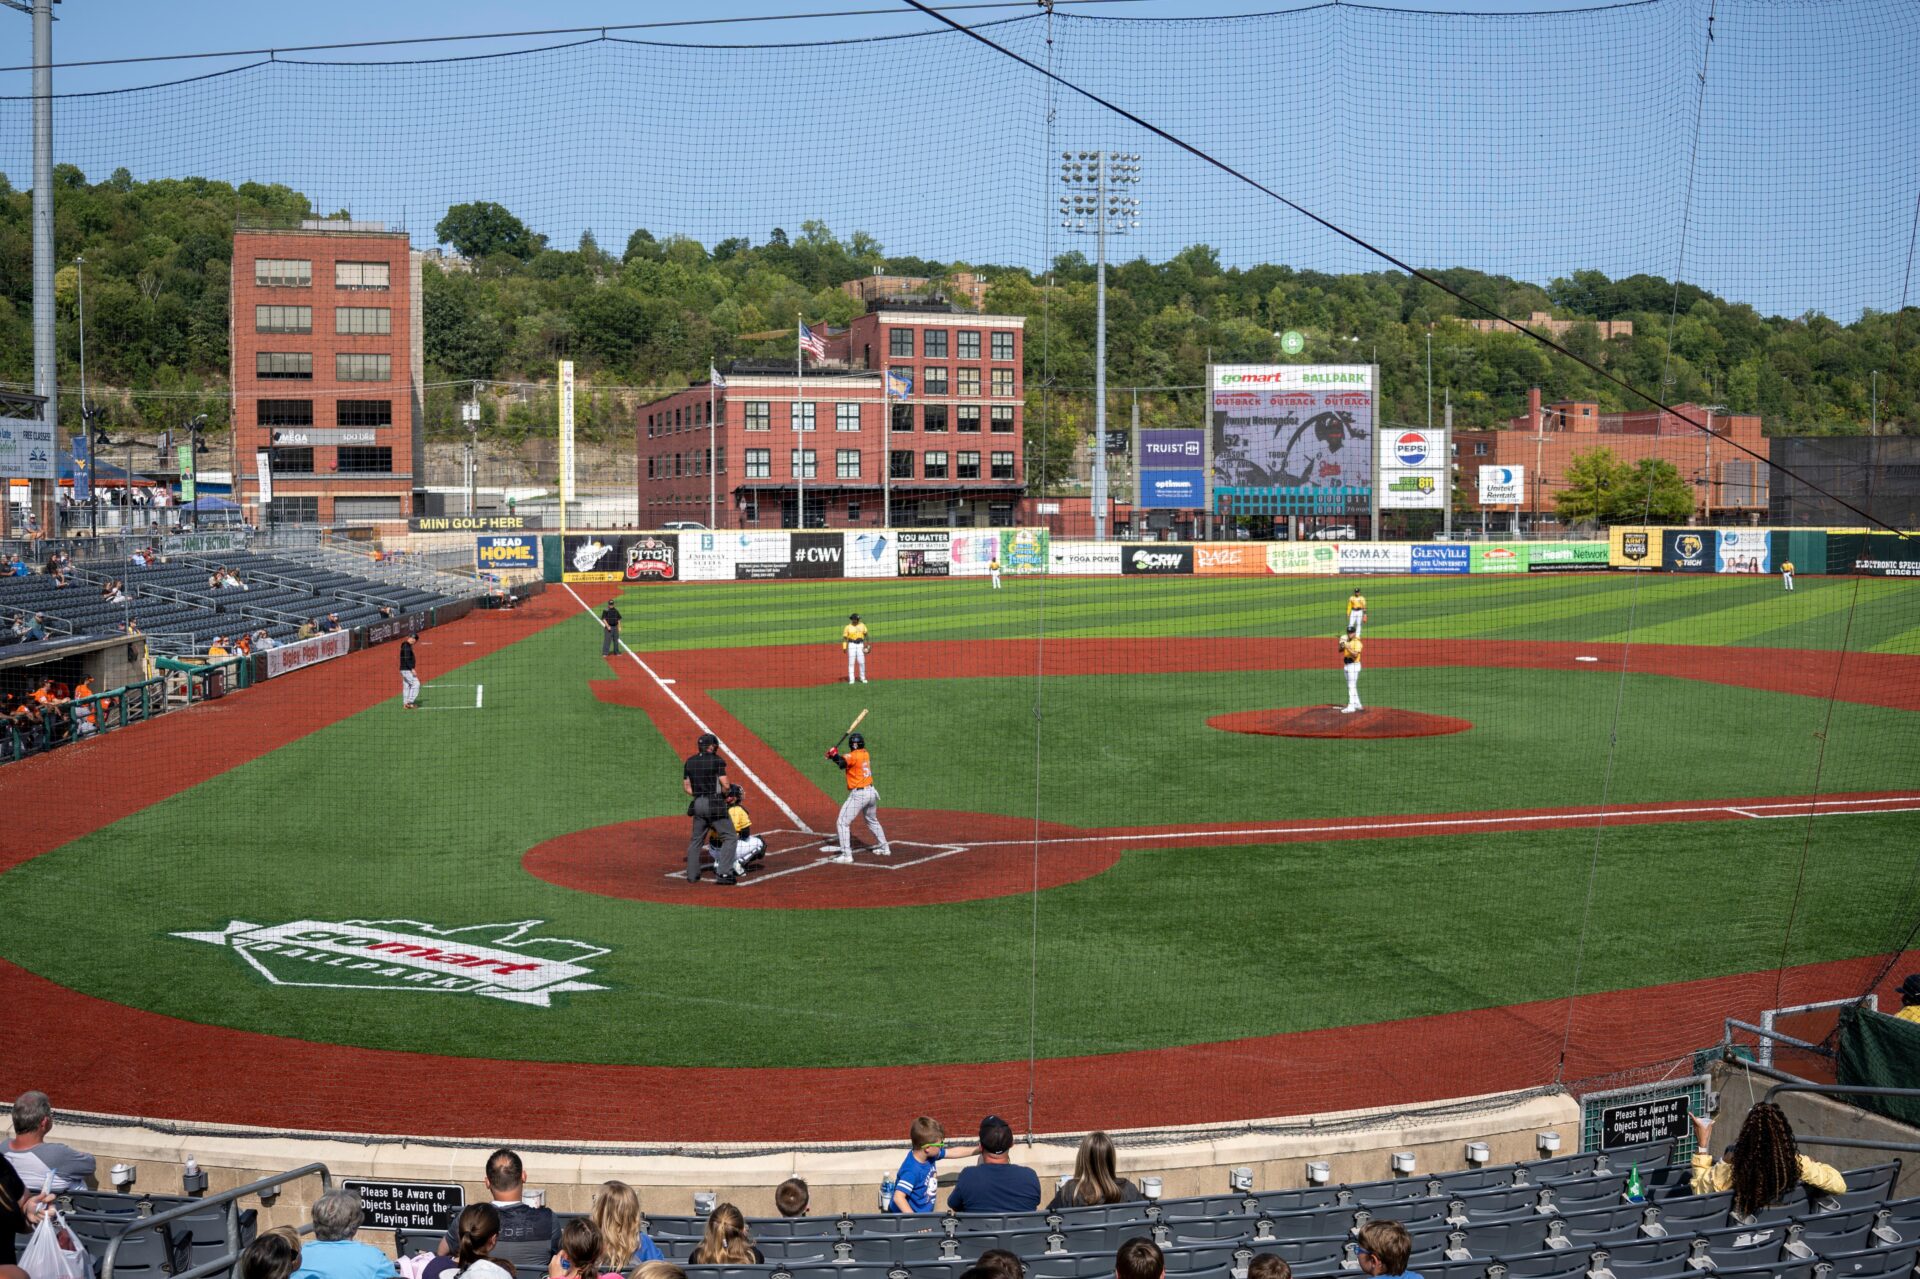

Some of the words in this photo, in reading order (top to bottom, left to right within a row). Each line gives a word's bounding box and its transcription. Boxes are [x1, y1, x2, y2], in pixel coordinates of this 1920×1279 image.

[1221, 373, 1281, 384] gomart
[1302, 373, 1366, 382] BALLPARK
[23, 430, 33, 439] FREE
[1146, 444, 1184, 452] TRUIST
[1418, 477, 1433, 488] 811
[420, 519, 449, 529] MINI
[452, 518, 487, 528] GOLF
[490, 518, 523, 528] HERE
[183, 536, 205, 551] FAMILY
[206, 535, 230, 550] SECTION
[493, 537, 522, 547] HEAD
[918, 533, 948, 541] MATTER
[481, 546, 534, 560] HOME.
[629, 548, 672, 567] PITCH
[795, 548, 842, 562] #CWV
[1341, 549, 1390, 558] KOMAX
[1543, 550, 1573, 560] Health
[1573, 550, 1608, 560] Network
[1149, 554, 1183, 566] CRW
[1855, 560, 1897, 568] ELECTRONIC
[282, 650, 300, 668] Bigley
[303, 645, 318, 662] Piggly
[321, 638, 338, 657] Wiggly
[282, 930, 542, 975] gomart
[250, 943, 471, 988] BALLPARK
[1615, 1109, 1636, 1120] Please
[1638, 1107, 1647, 1116] Be
[1649, 1104, 1669, 1114] Aware
[1671, 1101, 1678, 1110] of
[1614, 1120, 1638, 1134] Objects
[1640, 1117, 1665, 1129] Leaving
[1667, 1114, 1678, 1122] the
[1624, 1131, 1649, 1142] Playing
[360, 1186, 389, 1197] Please
[392, 1188, 403, 1198] Be
[407, 1189, 434, 1200] Aware
[437, 1190, 446, 1200] of
[360, 1200, 392, 1212] Objects
[395, 1201, 430, 1214] Leaving
[433, 1203, 448, 1213] the
[375, 1213, 409, 1227] Playing
[412, 1215, 434, 1226] Field
